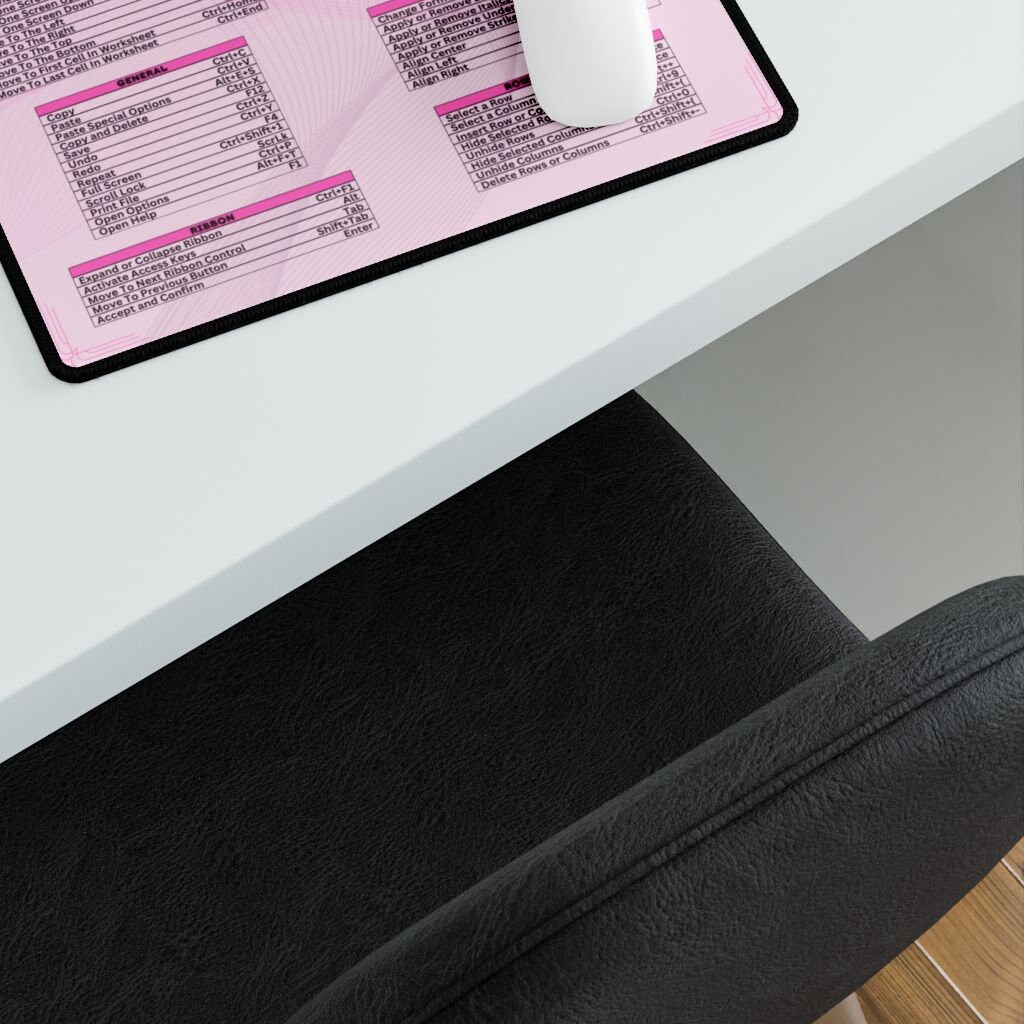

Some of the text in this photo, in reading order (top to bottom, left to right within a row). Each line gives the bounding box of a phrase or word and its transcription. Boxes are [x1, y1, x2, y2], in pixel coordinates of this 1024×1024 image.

[376, 6, 418, 24] Change
[381, 18, 415, 33] Apply
[415, 13, 427, 22] or
[19, 62, 34, 71] To
[34, 55, 55, 66] The
[55, 40, 97, 59] Bottom
[22, 71, 37, 80] To
[37, 61, 63, 75] First
[63, 53, 86, 66] Cell
[86, 50, 98, 58] In
[99, 29, 157, 54] Worksheet
[401, 43, 468, 70] Align Center
[115, 64, 169, 88] GENERAL
[244, 84, 265, 97] F12
[45, 108, 77, 123] Copy
[53, 97, 172, 142] Paste Special Options
[263, 112, 279, 123] F4
[444, 105, 480, 122] Select
[488, 95, 514, 107] Row
[49, 117, 82, 132] Paste
[58, 116, 150, 151] Copy and Delete
[256, 131, 289, 149] ScrLk
[62, 146, 91, 160] Save
[66, 154, 99, 169] Undo
[287, 159, 302, 170] F1
[475, 145, 565, 180] Unhide Columns
[479, 140, 611, 189] Delete Rows or Columns
[71, 164, 102, 179] Redo
[75, 169, 117, 189] Repeat
[79, 172, 142, 198] Full Screen
[84, 181, 146, 208] Scroll Lock
[88, 195, 141, 217] Print File
[341, 192, 359, 204] Alt
[342, 202, 364, 215] Tab
[93, 195, 170, 227] Open Options
[97, 211, 159, 236] Open Help
[188, 213, 236, 235] RIBBON
[342, 223, 374, 238] Enter
[77, 230, 223, 285] Expand or Collapse Ribbon
[82, 251, 197, 295] Activate Access Keys
[86, 243, 247, 305] Move To Next Ribbon Control
[91, 262, 229, 315] Move To Previous Button
[95, 282, 205, 325] Accept and Confirm
